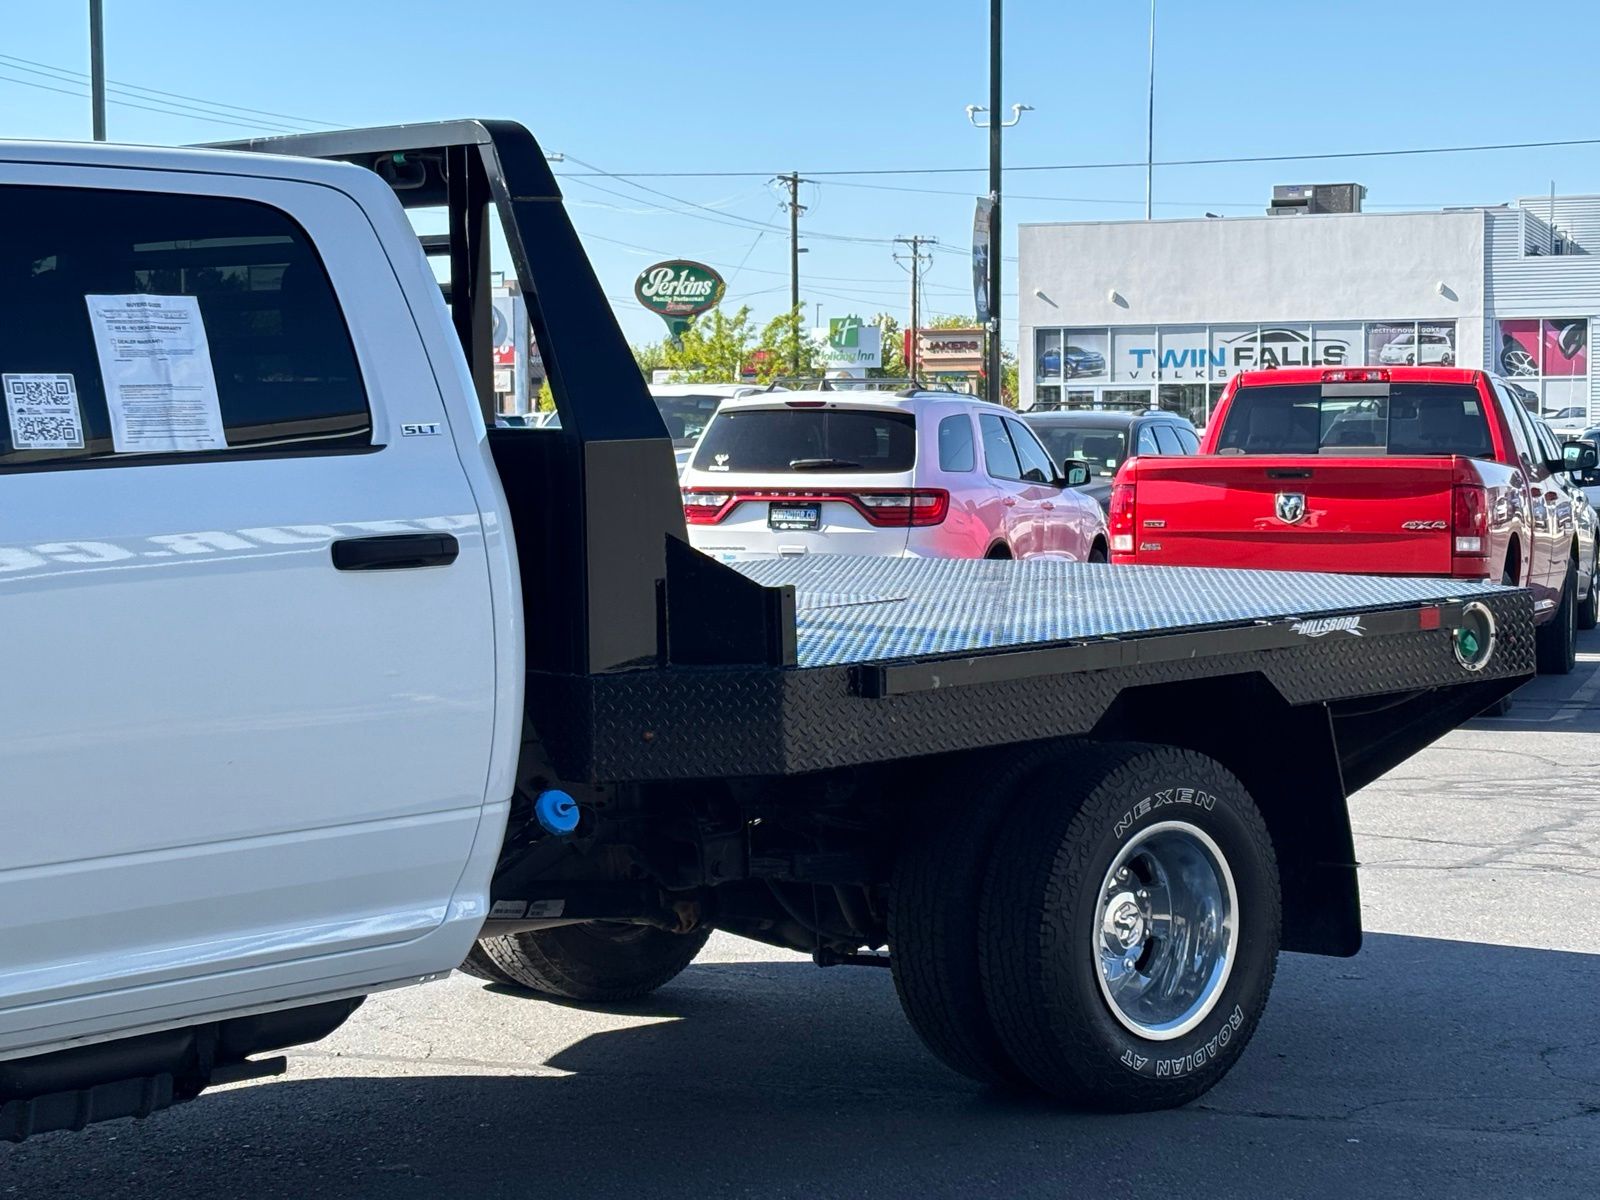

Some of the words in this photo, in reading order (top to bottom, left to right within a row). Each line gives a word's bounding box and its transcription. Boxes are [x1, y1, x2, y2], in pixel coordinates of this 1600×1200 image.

[642, 268, 713, 296] Perkins
[857, 349, 875, 361] Inn
[926, 341, 978, 350] JAKERS
[1129, 347, 1226, 369] TWIN
[1234, 345, 1347, 367] FALLS
[1129, 369, 1255, 379] VOLKS
[403, 424, 438, 435] SLT
[1298, 616, 1360, 635] HILLSBORO
[1113, 787, 1217, 840] NEXEN
[1156, 1004, 1245, 1077] ROADIAN
[1121, 1049, 1149, 1071] AT
